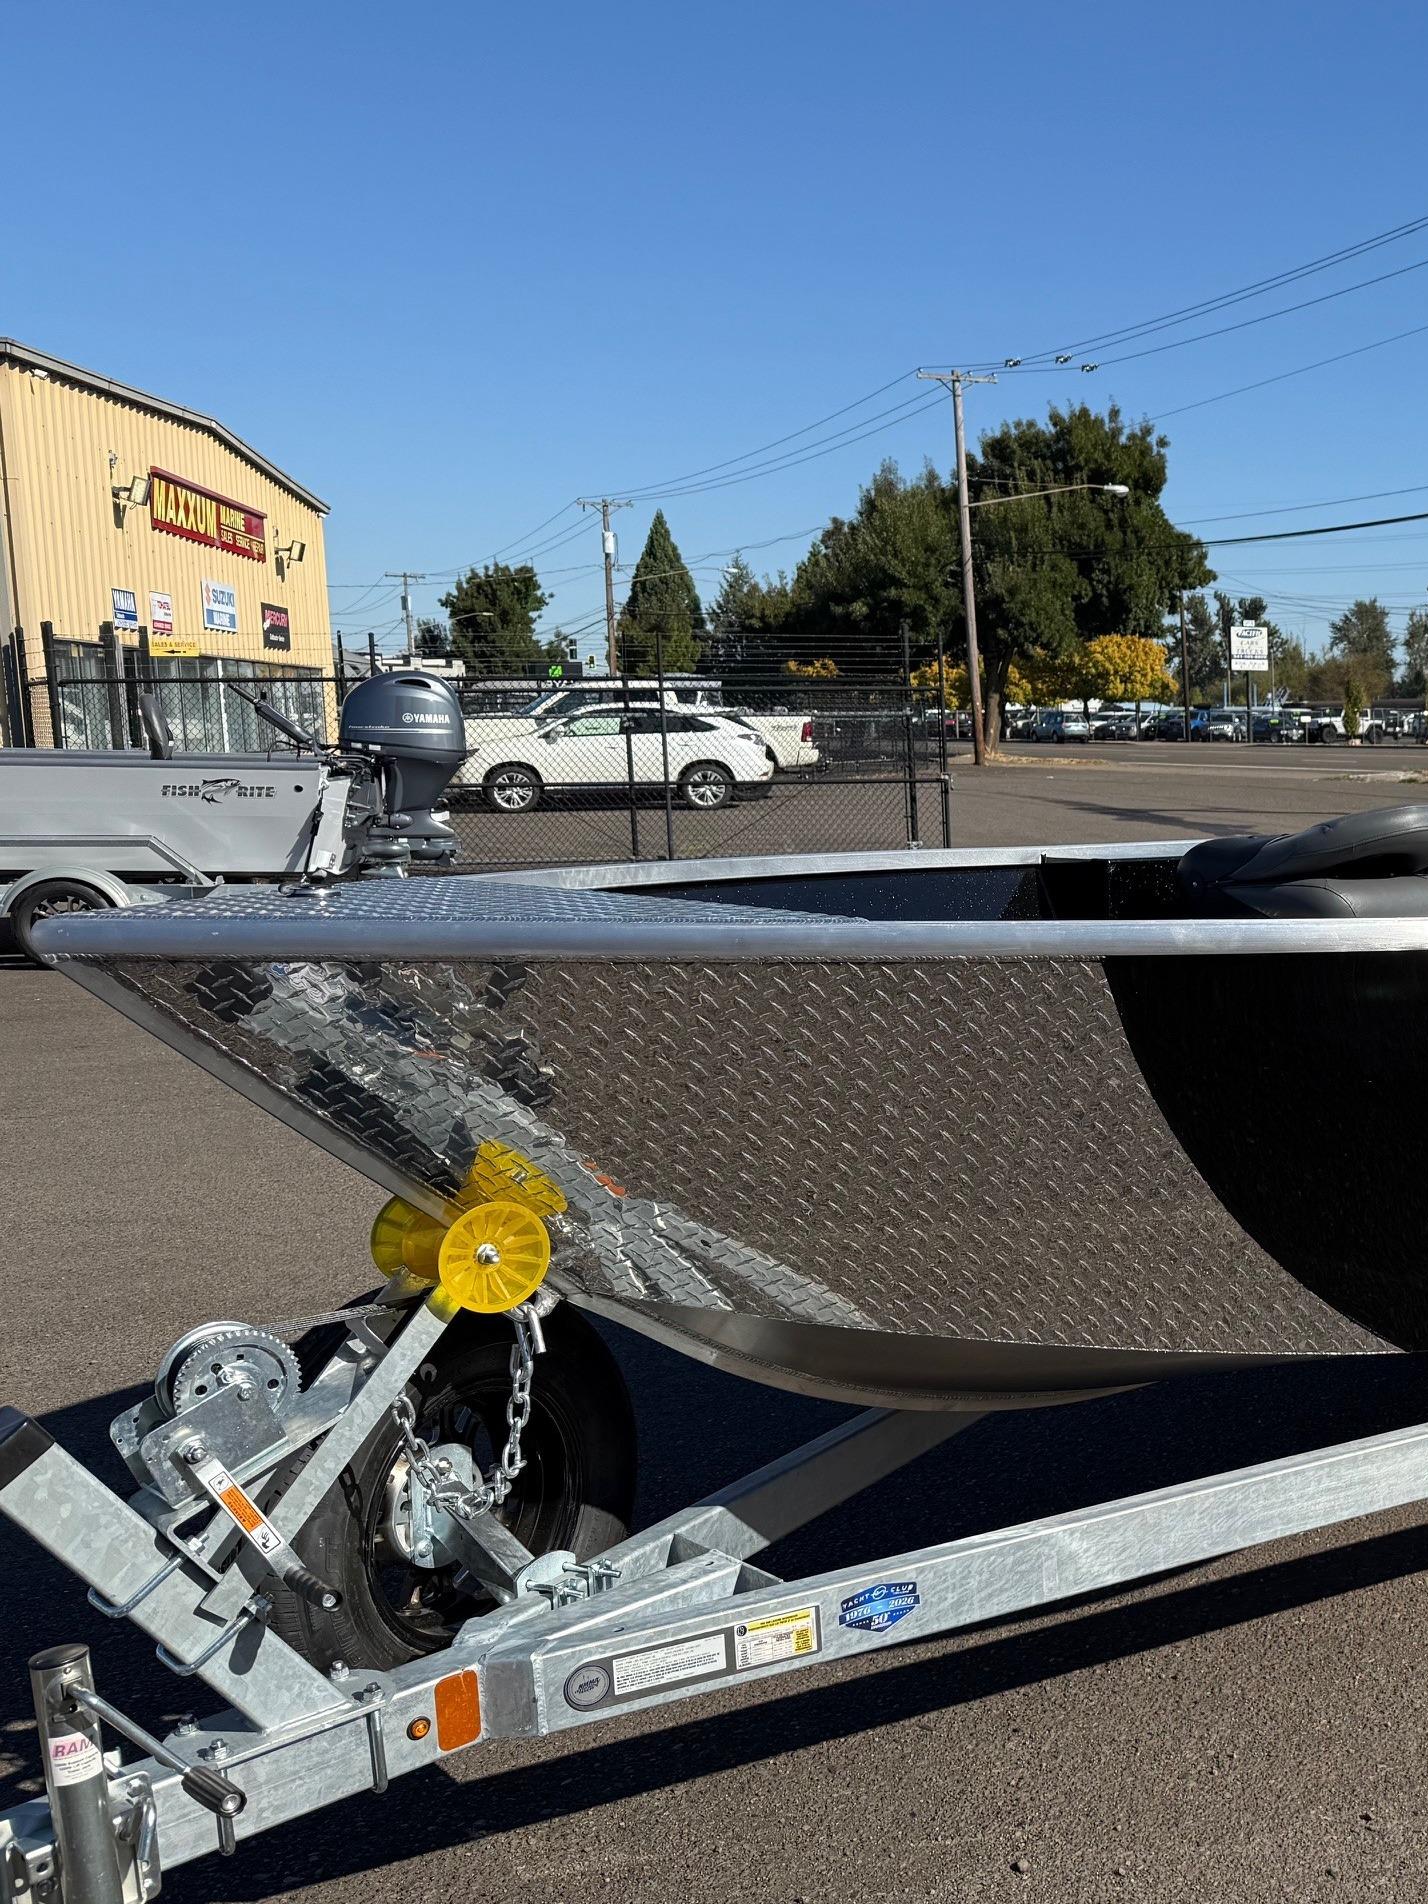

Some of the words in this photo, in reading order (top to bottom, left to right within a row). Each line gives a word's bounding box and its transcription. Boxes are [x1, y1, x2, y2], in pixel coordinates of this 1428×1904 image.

[153, 477, 217, 539] MAXXUM
[220, 504, 246, 532] MARINE
[212, 588, 235, 607] SUZUKI
[413, 713, 450, 724] YAMAHA
[161, 785, 201, 797] FISH
[236, 786, 276, 798] RITE
[842, 1593, 870, 1609] YACHT
[890, 1584, 913, 1593] CLUB
[845, 1606, 871, 1621] 1976
[888, 1596, 915, 1609] 2026
[871, 1612, 891, 1626] 50
[55, 1739, 93, 1758] RAM
